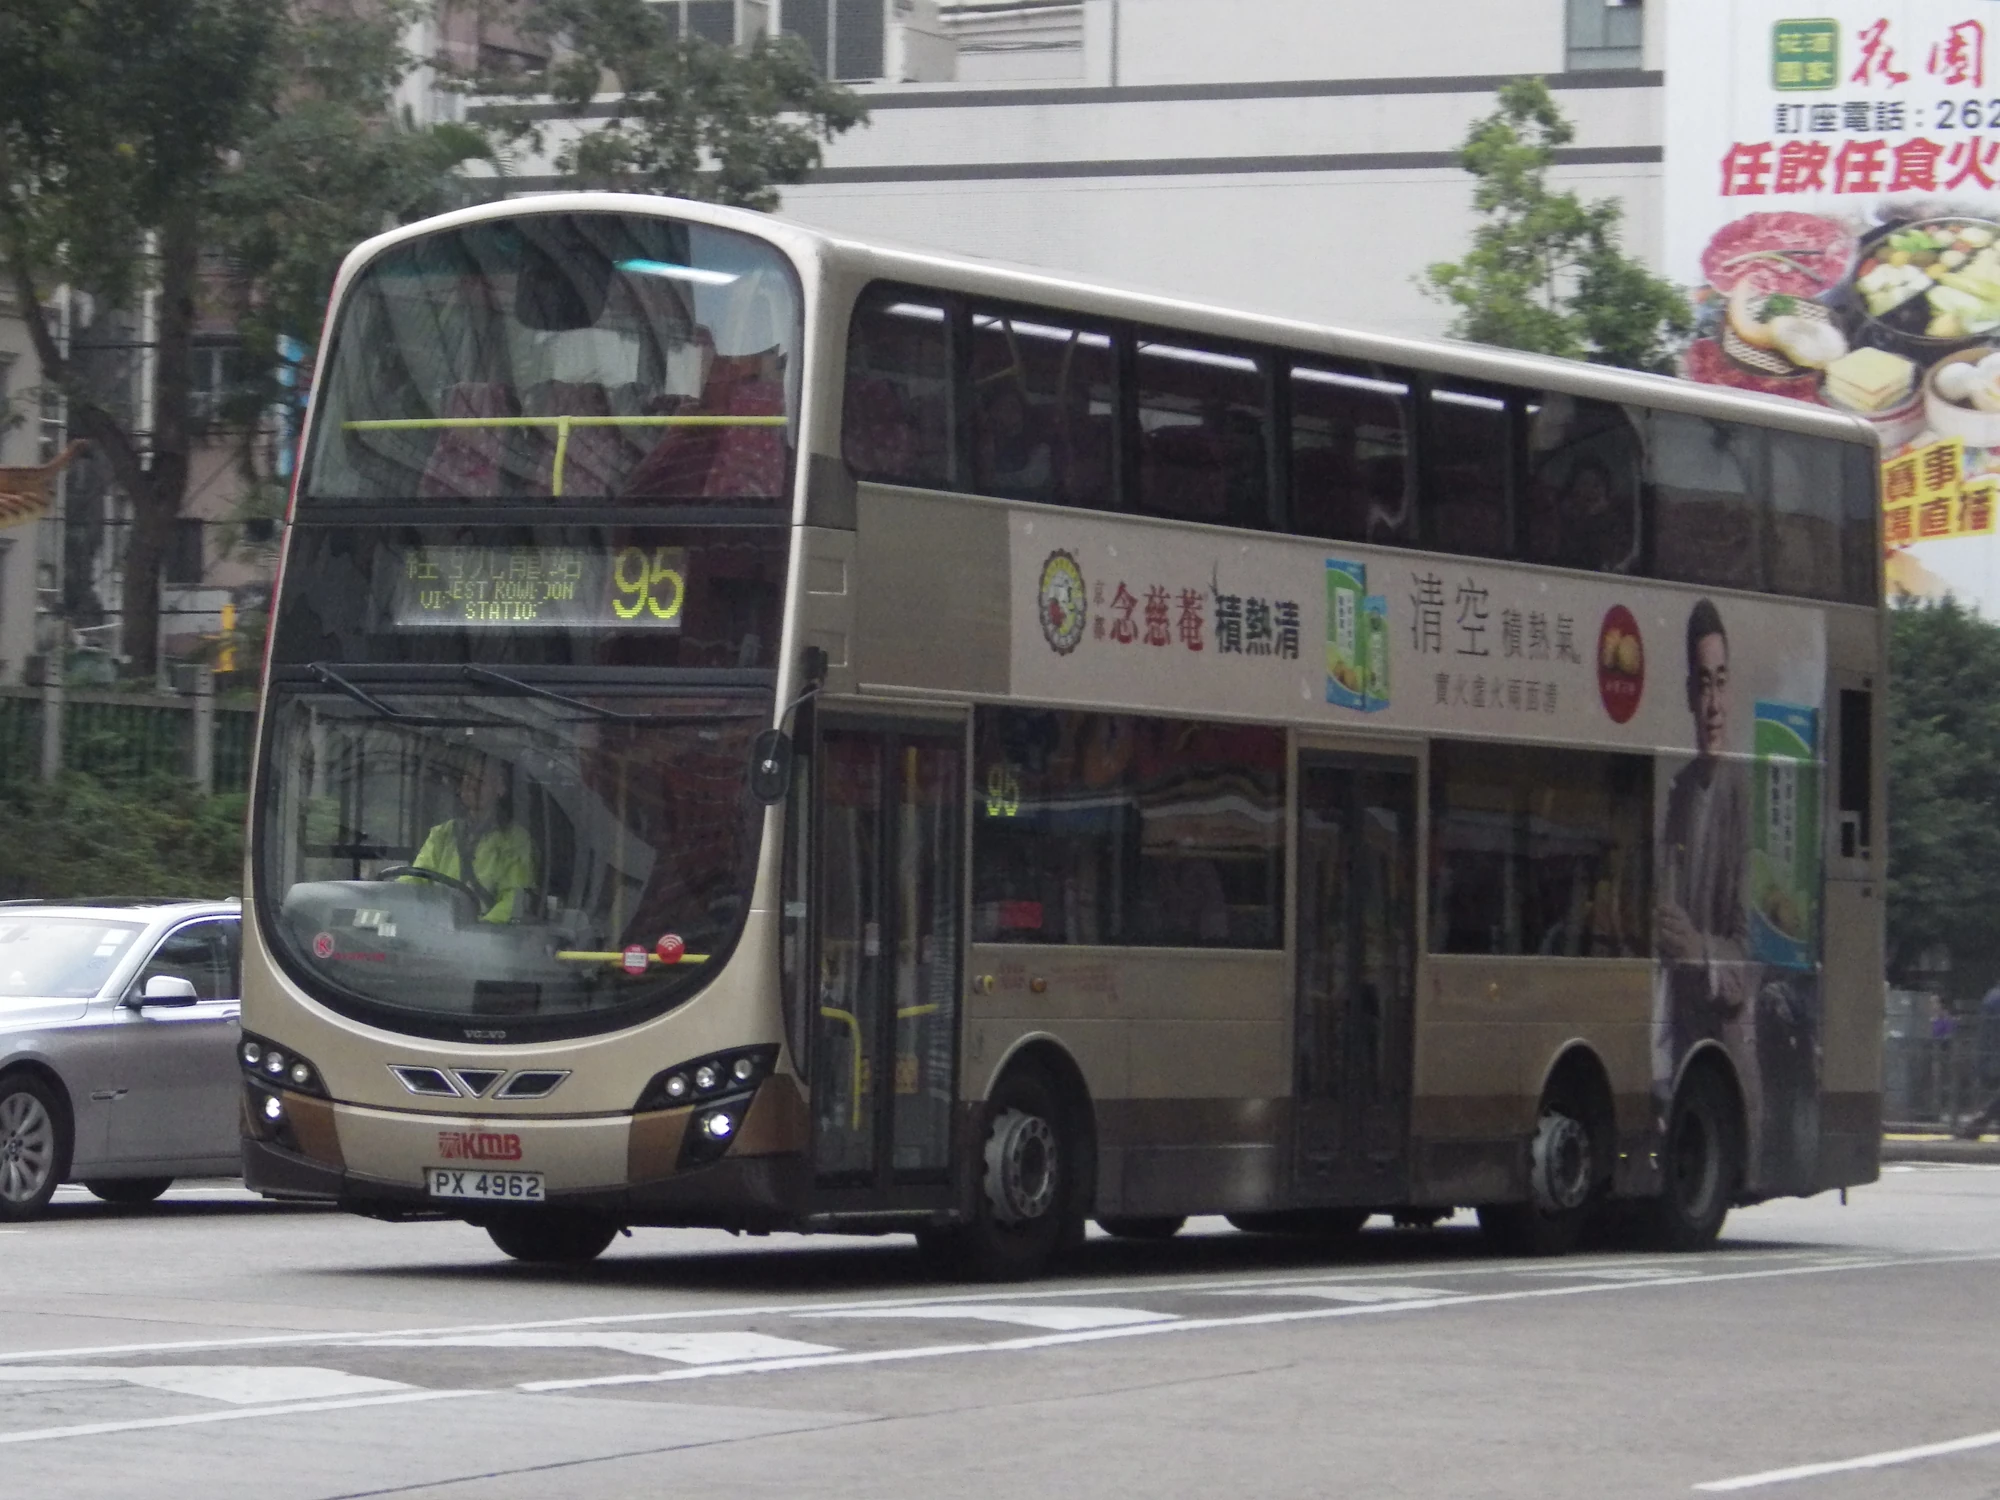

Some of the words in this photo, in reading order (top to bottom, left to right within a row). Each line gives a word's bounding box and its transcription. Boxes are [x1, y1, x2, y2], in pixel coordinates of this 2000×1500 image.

[613, 548, 685, 618] 95
[436, 1173, 465, 1194] PX
[475, 1175, 540, 1198] 4962
